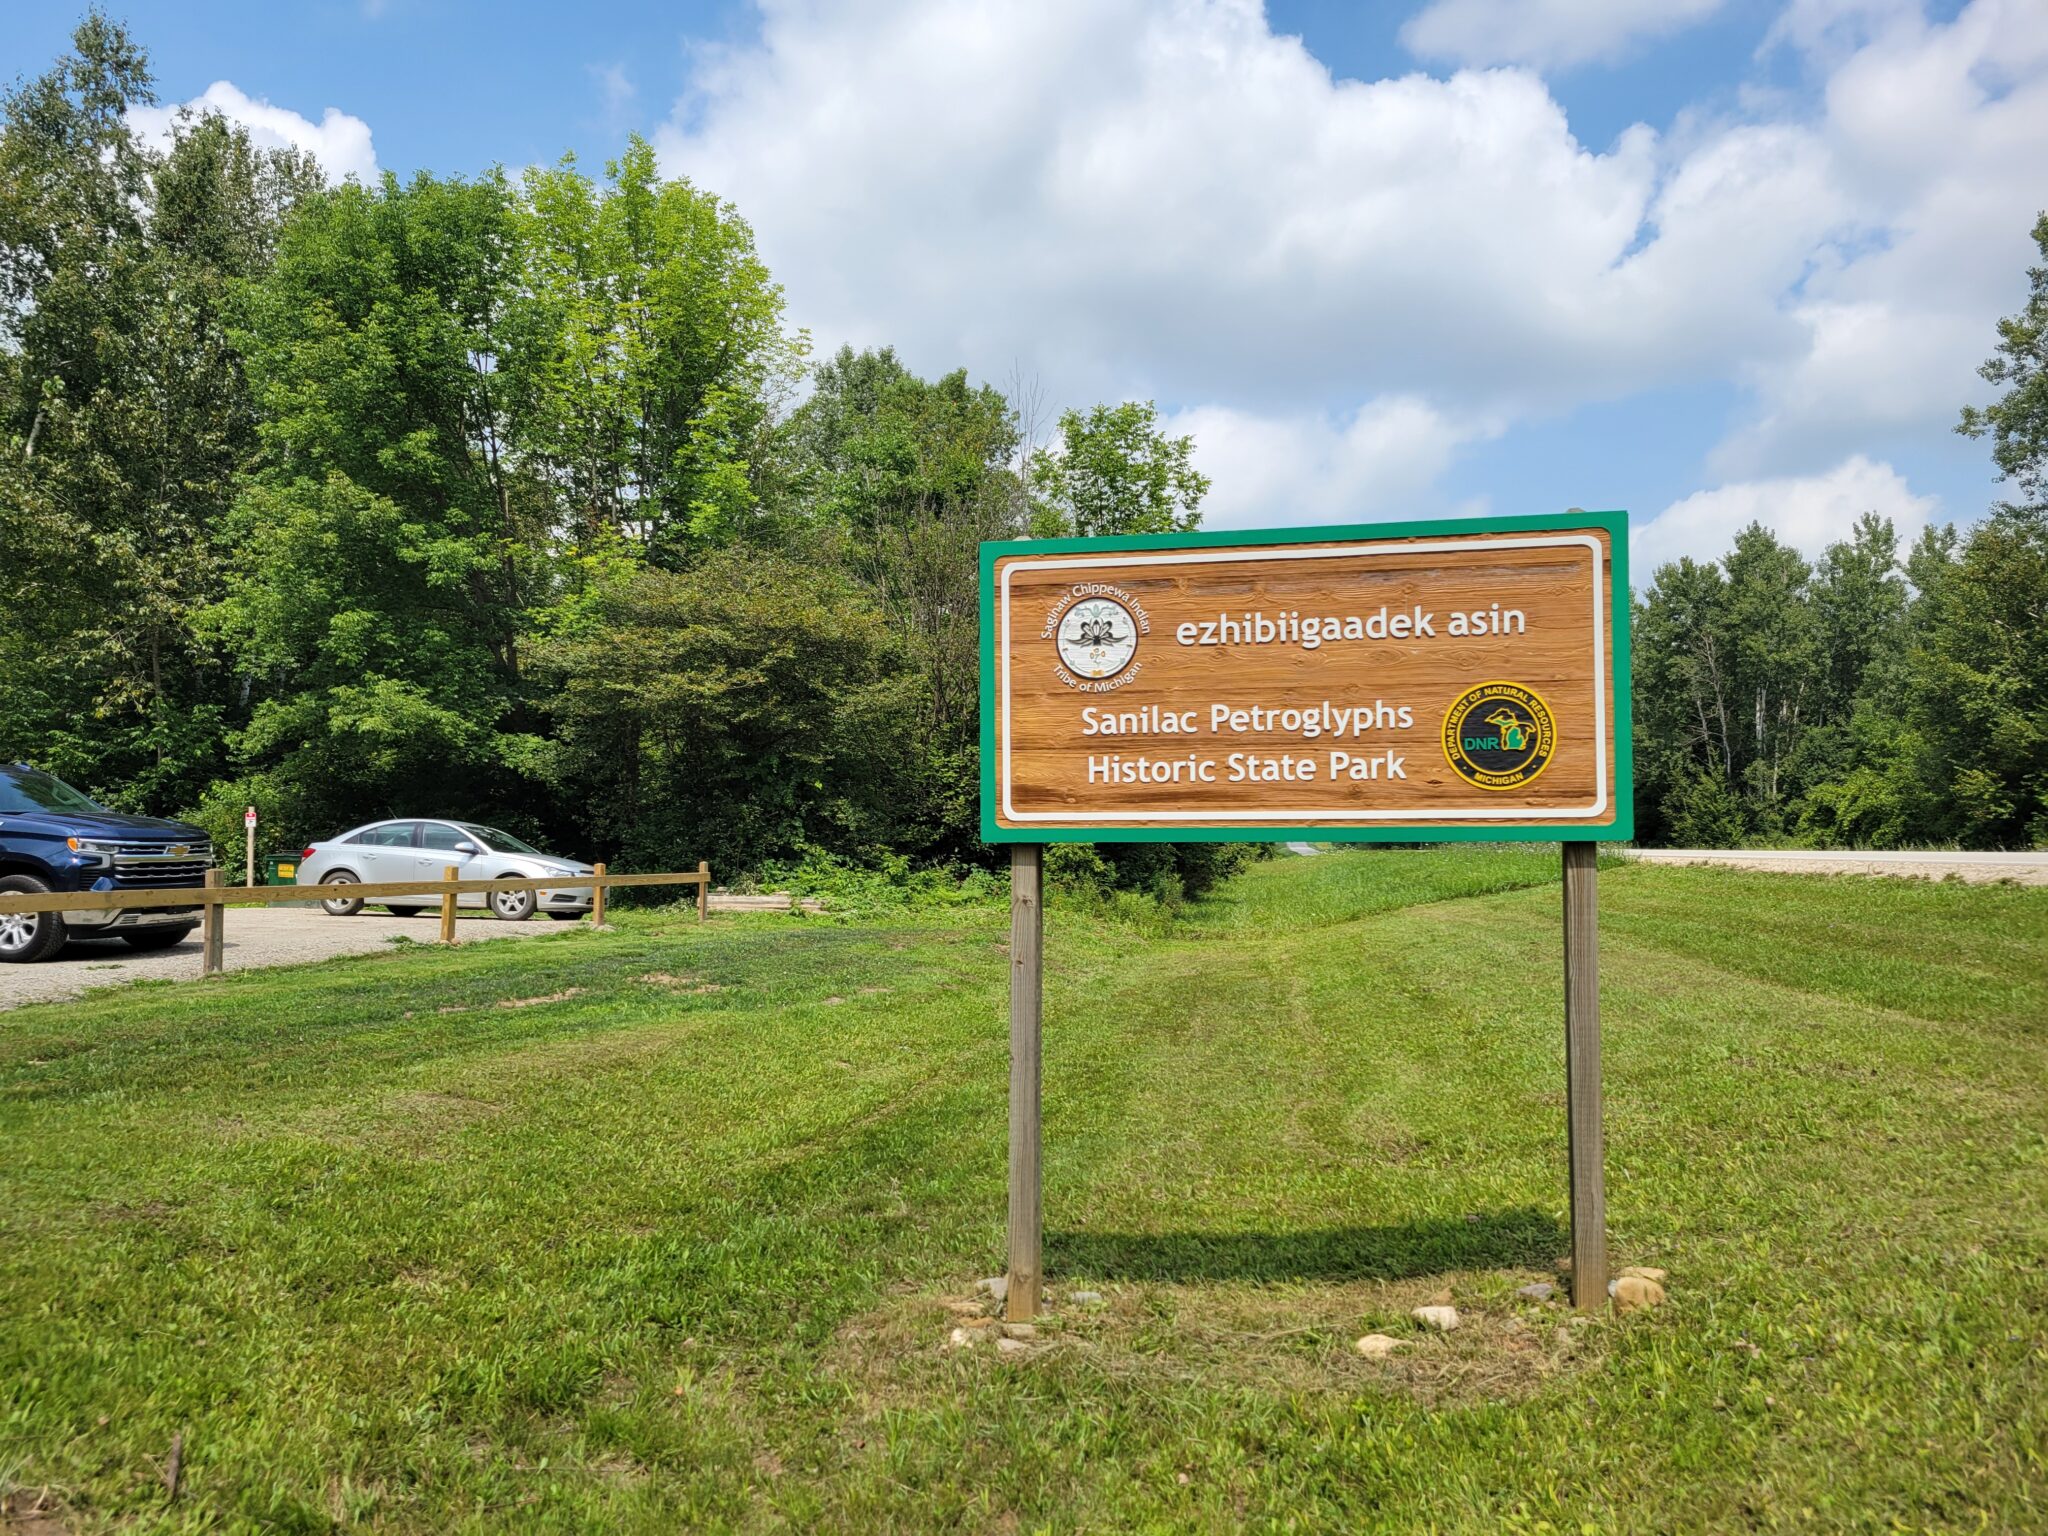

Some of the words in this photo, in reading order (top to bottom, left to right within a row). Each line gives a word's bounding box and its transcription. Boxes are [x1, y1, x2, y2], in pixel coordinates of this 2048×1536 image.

[1041, 594, 1071, 639] Saginaw
[1072, 583, 1130, 601] Chippewa
[1130, 598, 1151, 634] Indian
[1176, 604, 1436, 649] ezhibiigaadek
[1448, 603, 1525, 637] asin
[1053, 664, 1077, 687] Tribe
[1079, 683, 1091, 692] of
[1094, 662, 1143, 692] Michigan
[1082, 704, 1198, 735] Sanilac
[1211, 700, 1414, 738] Petroglyphs
[1447, 700, 1470, 760] DEPARTMENT
[1469, 691, 1482, 702] OF
[1484, 686, 1529, 702] NATURAL
[1529, 700, 1552, 758] RESOURCES
[1464, 737, 1499, 751] DNR
[1088, 753, 1215, 784] Historic
[1228, 752, 1317, 782] State
[1330, 750, 1407, 780] Park
[1474, 772, 1524, 785] MICHIGAN
